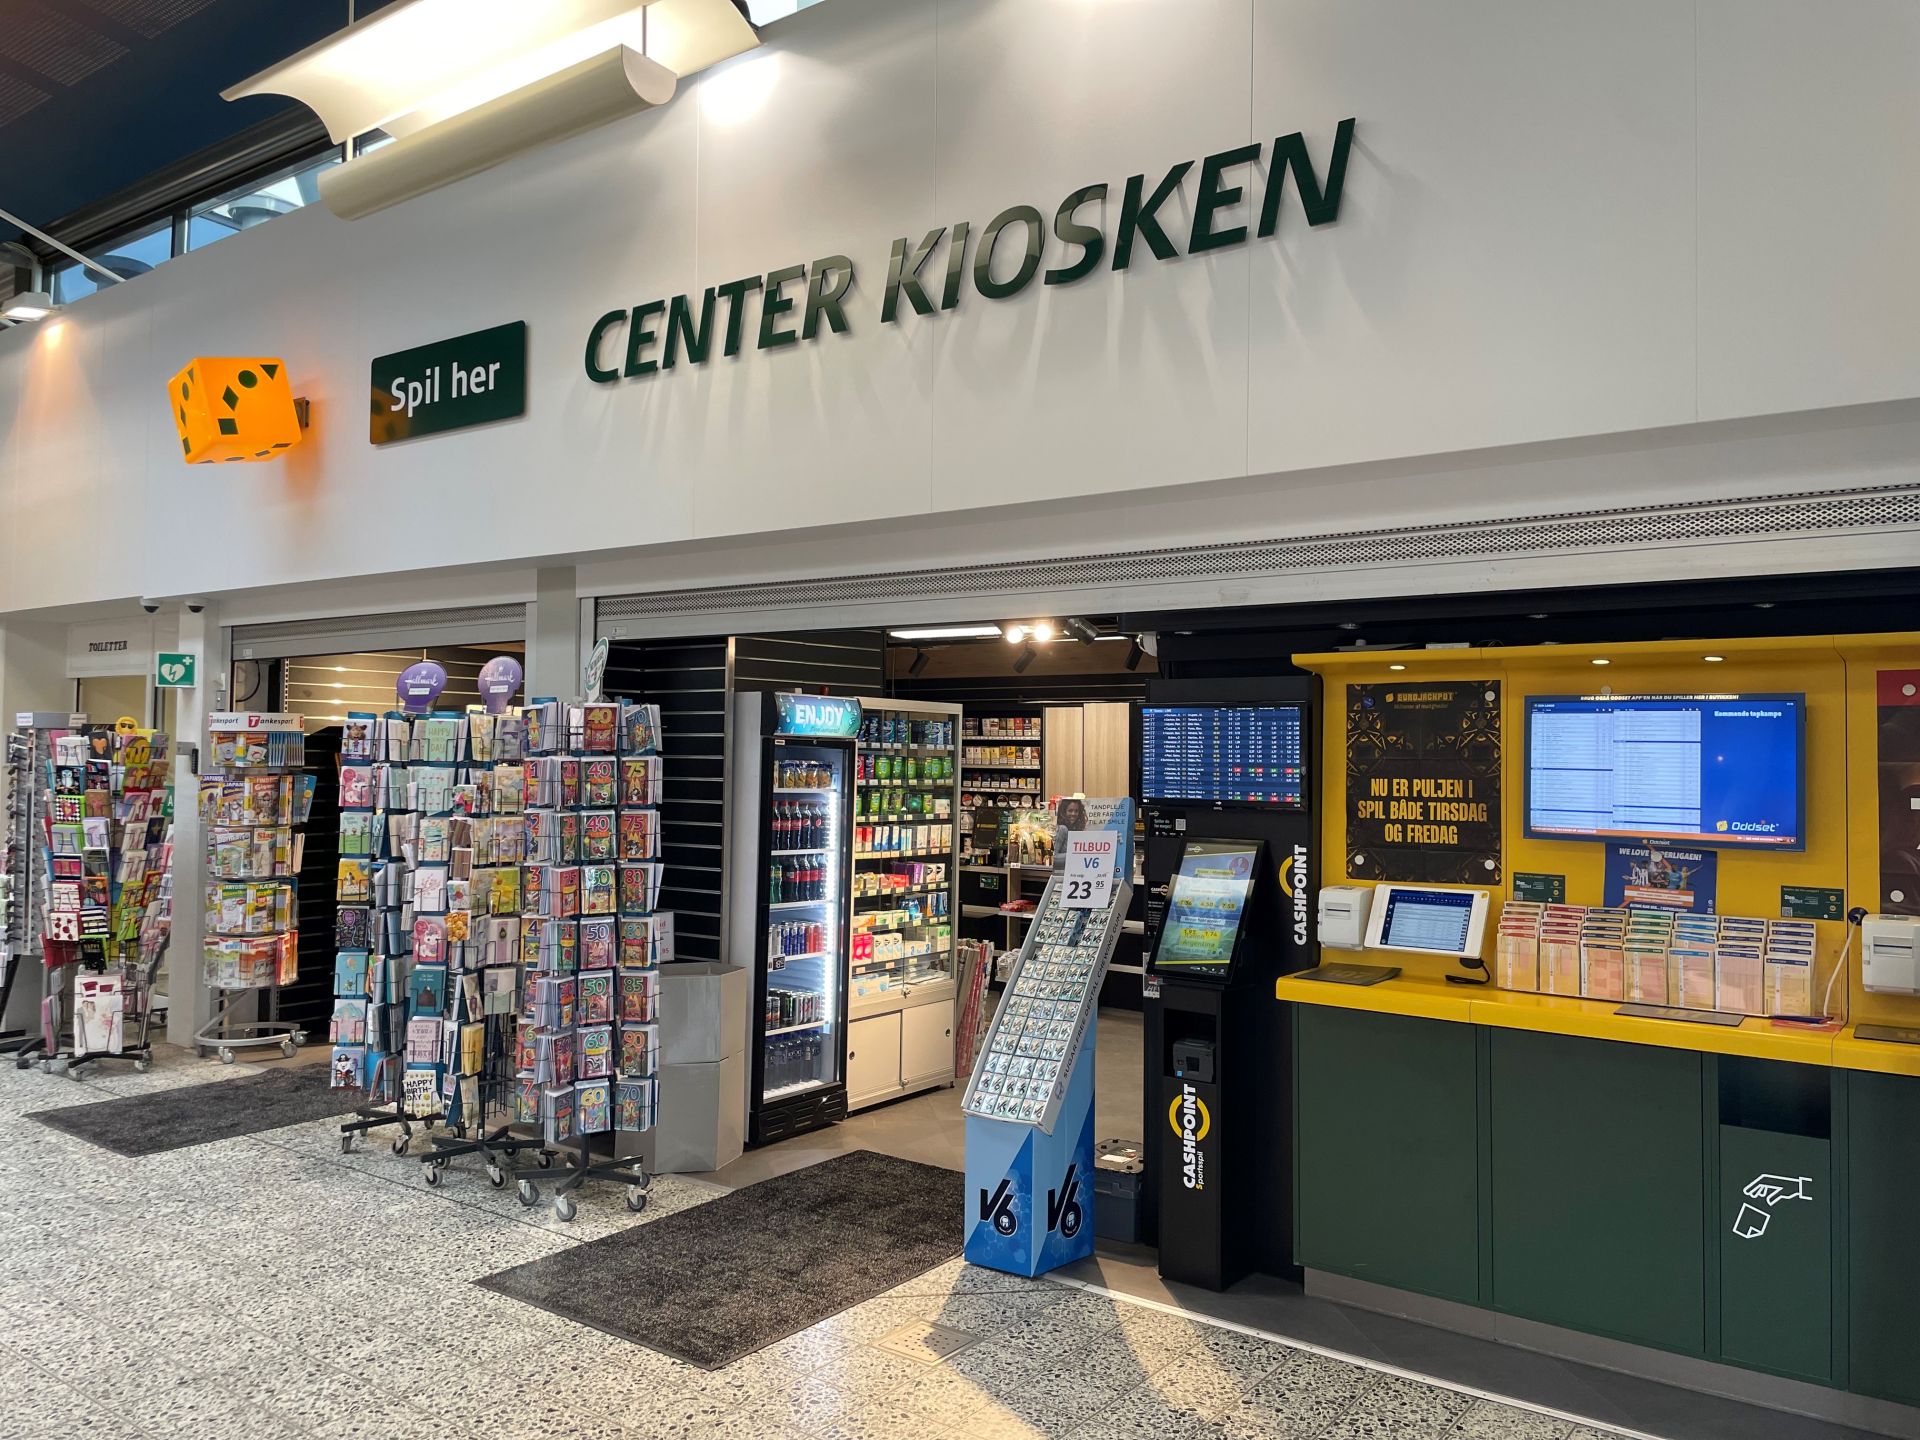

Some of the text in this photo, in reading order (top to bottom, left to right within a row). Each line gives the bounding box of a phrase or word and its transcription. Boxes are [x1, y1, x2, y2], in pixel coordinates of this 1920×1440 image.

[584, 118, 1356, 384] CENTER KIOSKEN
[391, 362, 501, 418] Spil her
[89, 641, 128, 652] TOILETTER
[405, 671, 439, 689] Hallmark
[484, 669, 516, 687] Hallmark
[1397, 691, 1454, 702] EUROJACKPOT
[587, 708, 613, 723] 40
[795, 703, 844, 726] ENJOY
[1750, 710, 1783, 719] topkampe
[588, 762, 611, 778] 40
[625, 762, 646, 778] 75
[1370, 778, 1473, 798] NU ER PULJEN I
[1357, 799, 1488, 822] SPIL BÅDE TIRSDAG
[586, 815, 609, 831] 40
[625, 815, 643, 831] 75
[1731, 821, 1776, 832] Oddset
[1384, 823, 1458, 845] OG FREDAG
[1073, 841, 1111, 852] TILBUD
[1619, 848, 1702, 861] WE LOVE ERLIGAEN!
[1084, 857, 1100, 869] V6
[530, 867, 541, 883] 3
[624, 869, 644, 885] 80
[1067, 880, 1105, 900] 23 95
[1294, 844, 1307, 946] CASHPOINT
[528, 920, 541, 936] 4
[586, 924, 609, 941] 50
[624, 924, 645, 939] 80
[584, 979, 606, 996] 50
[624, 978, 644, 993] 85
[1063, 912, 1122, 1079] SUGAR FREE DENTAL CHEWING GUM
[524, 1025, 536, 1042] 6
[585, 1032, 609, 1049] 60
[624, 1031, 645, 1048] 90
[405, 1078, 433, 1089] HAPPY
[406, 1087, 432, 1095] BIRTH-
[523, 1079, 535, 1096] 7
[407, 1094, 422, 1102] DAY
[581, 1088, 605, 1106] 60
[620, 1085, 641, 1101] 70
[1183, 1083, 1197, 1189] CASHPOINT
[980, 1178, 1018, 1237] V6
[1047, 1163, 1083, 1239] V6
